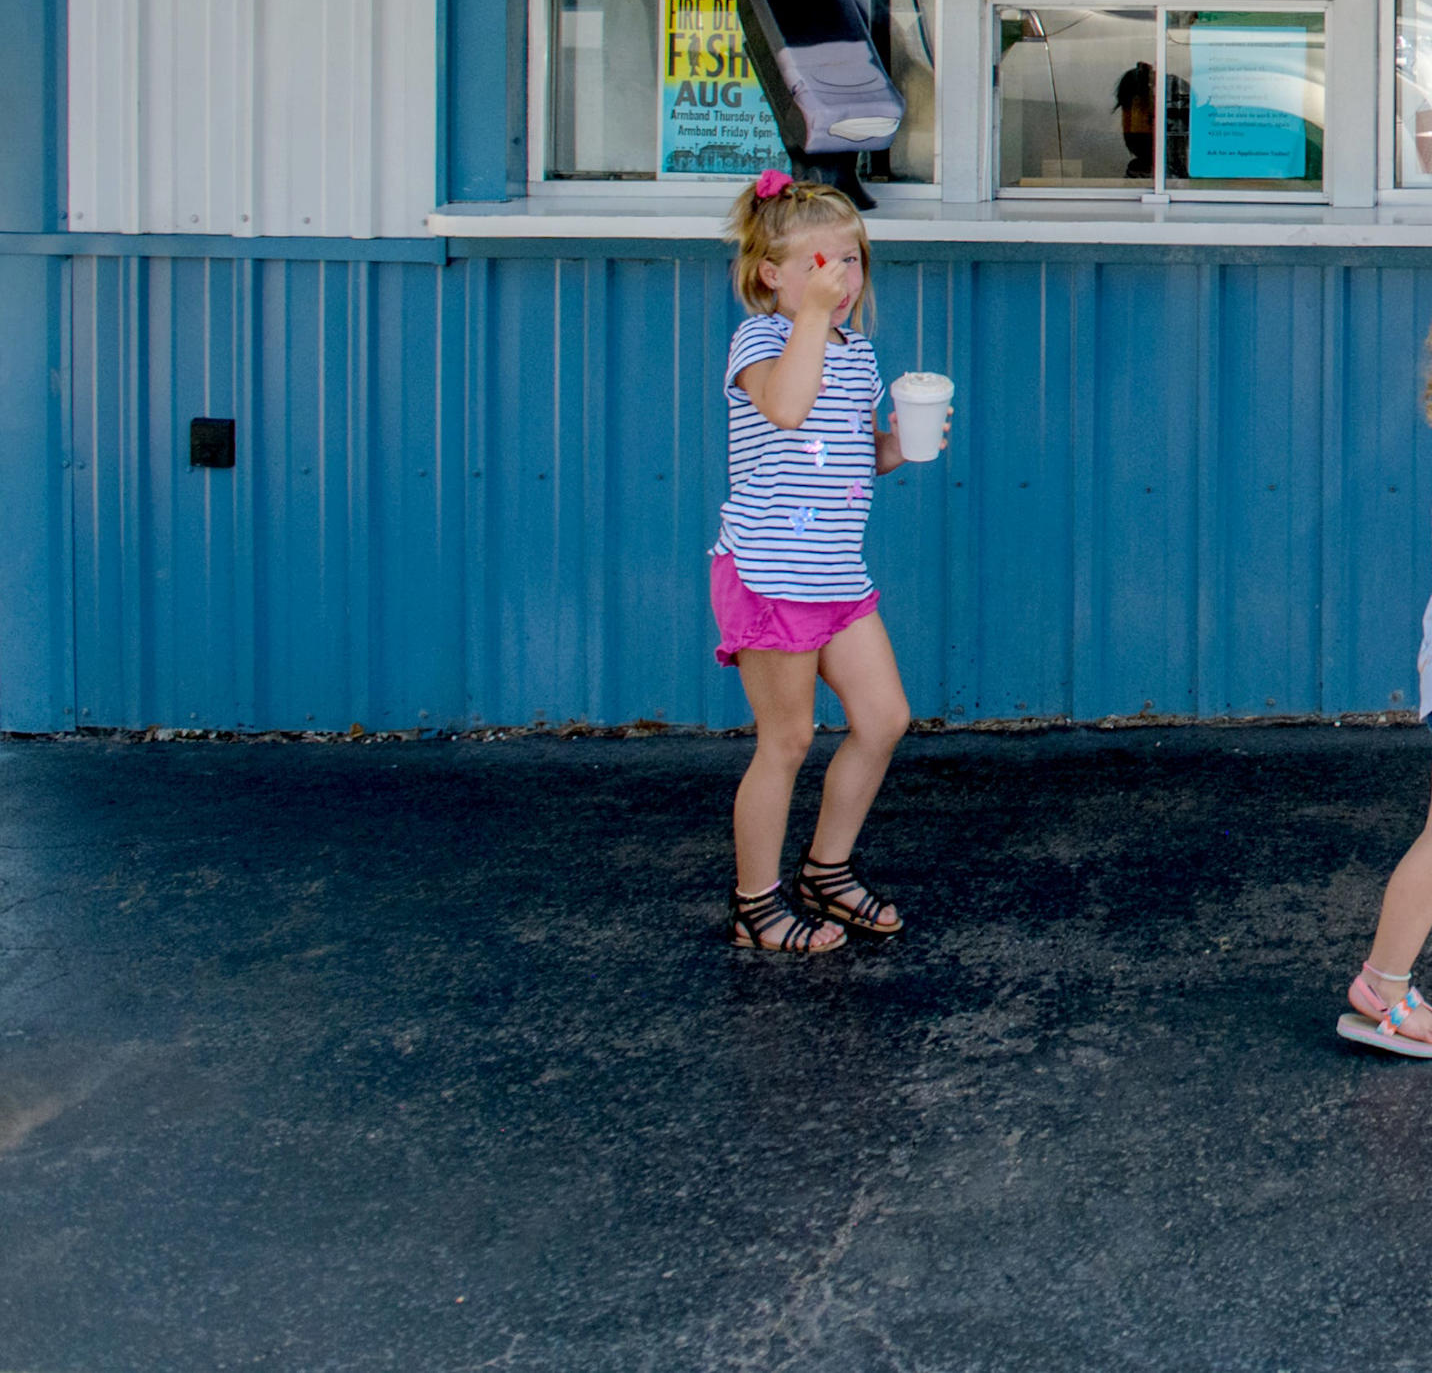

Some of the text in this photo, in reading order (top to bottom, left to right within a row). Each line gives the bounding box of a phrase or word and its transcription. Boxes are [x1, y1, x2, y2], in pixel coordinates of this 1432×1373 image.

[674, 80, 742, 108] AUG
[670, 109, 756, 125] Armband Thursday
[678, 125, 718, 137] Armband
[720, 126, 750, 140] Friday
